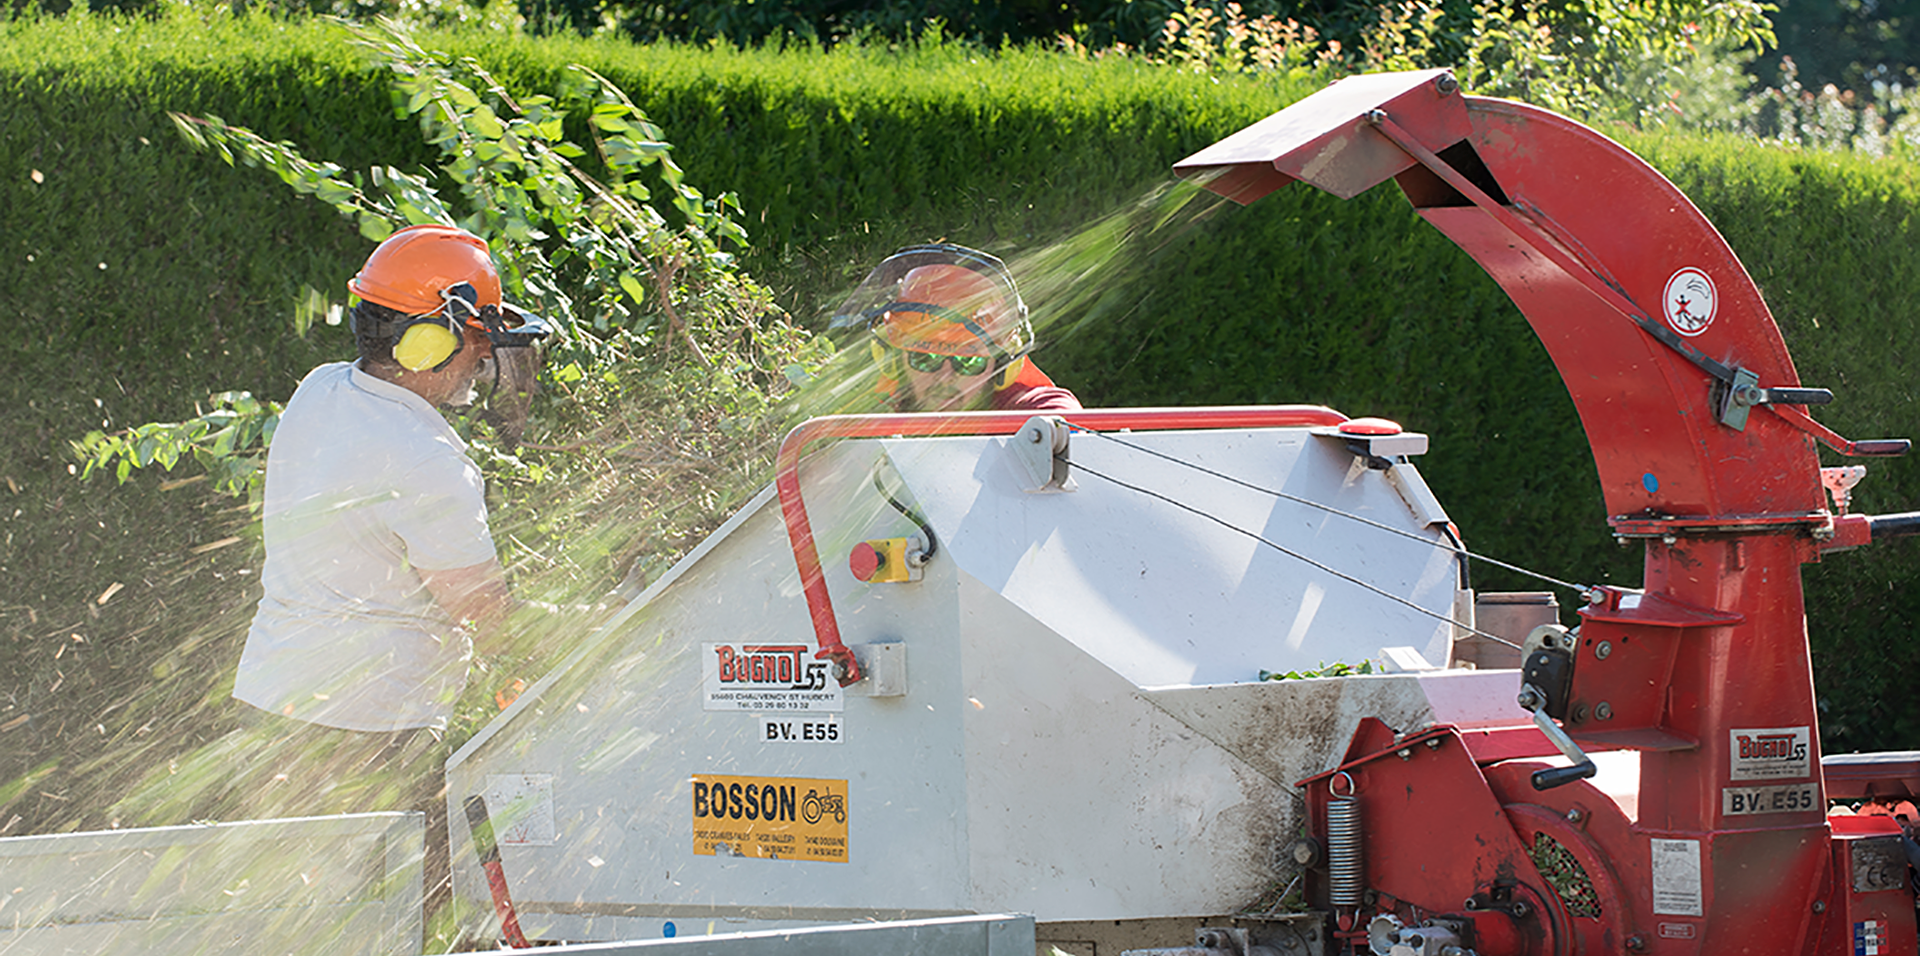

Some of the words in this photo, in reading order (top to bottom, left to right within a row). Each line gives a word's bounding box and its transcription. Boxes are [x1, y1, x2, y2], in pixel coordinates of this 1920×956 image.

[715, 645, 808, 683] BUGNOT
[797, 664, 828, 691] 55
[766, 722, 796, 740] BV.
[803, 722, 838, 740] E55
[1736, 733, 1797, 759] BUGNOT
[1790, 744, 1807, 761] 55
[694, 782, 796, 822] BOSSON
[1731, 793, 1764, 812] BV.
[1772, 790, 1812, 809] E55
